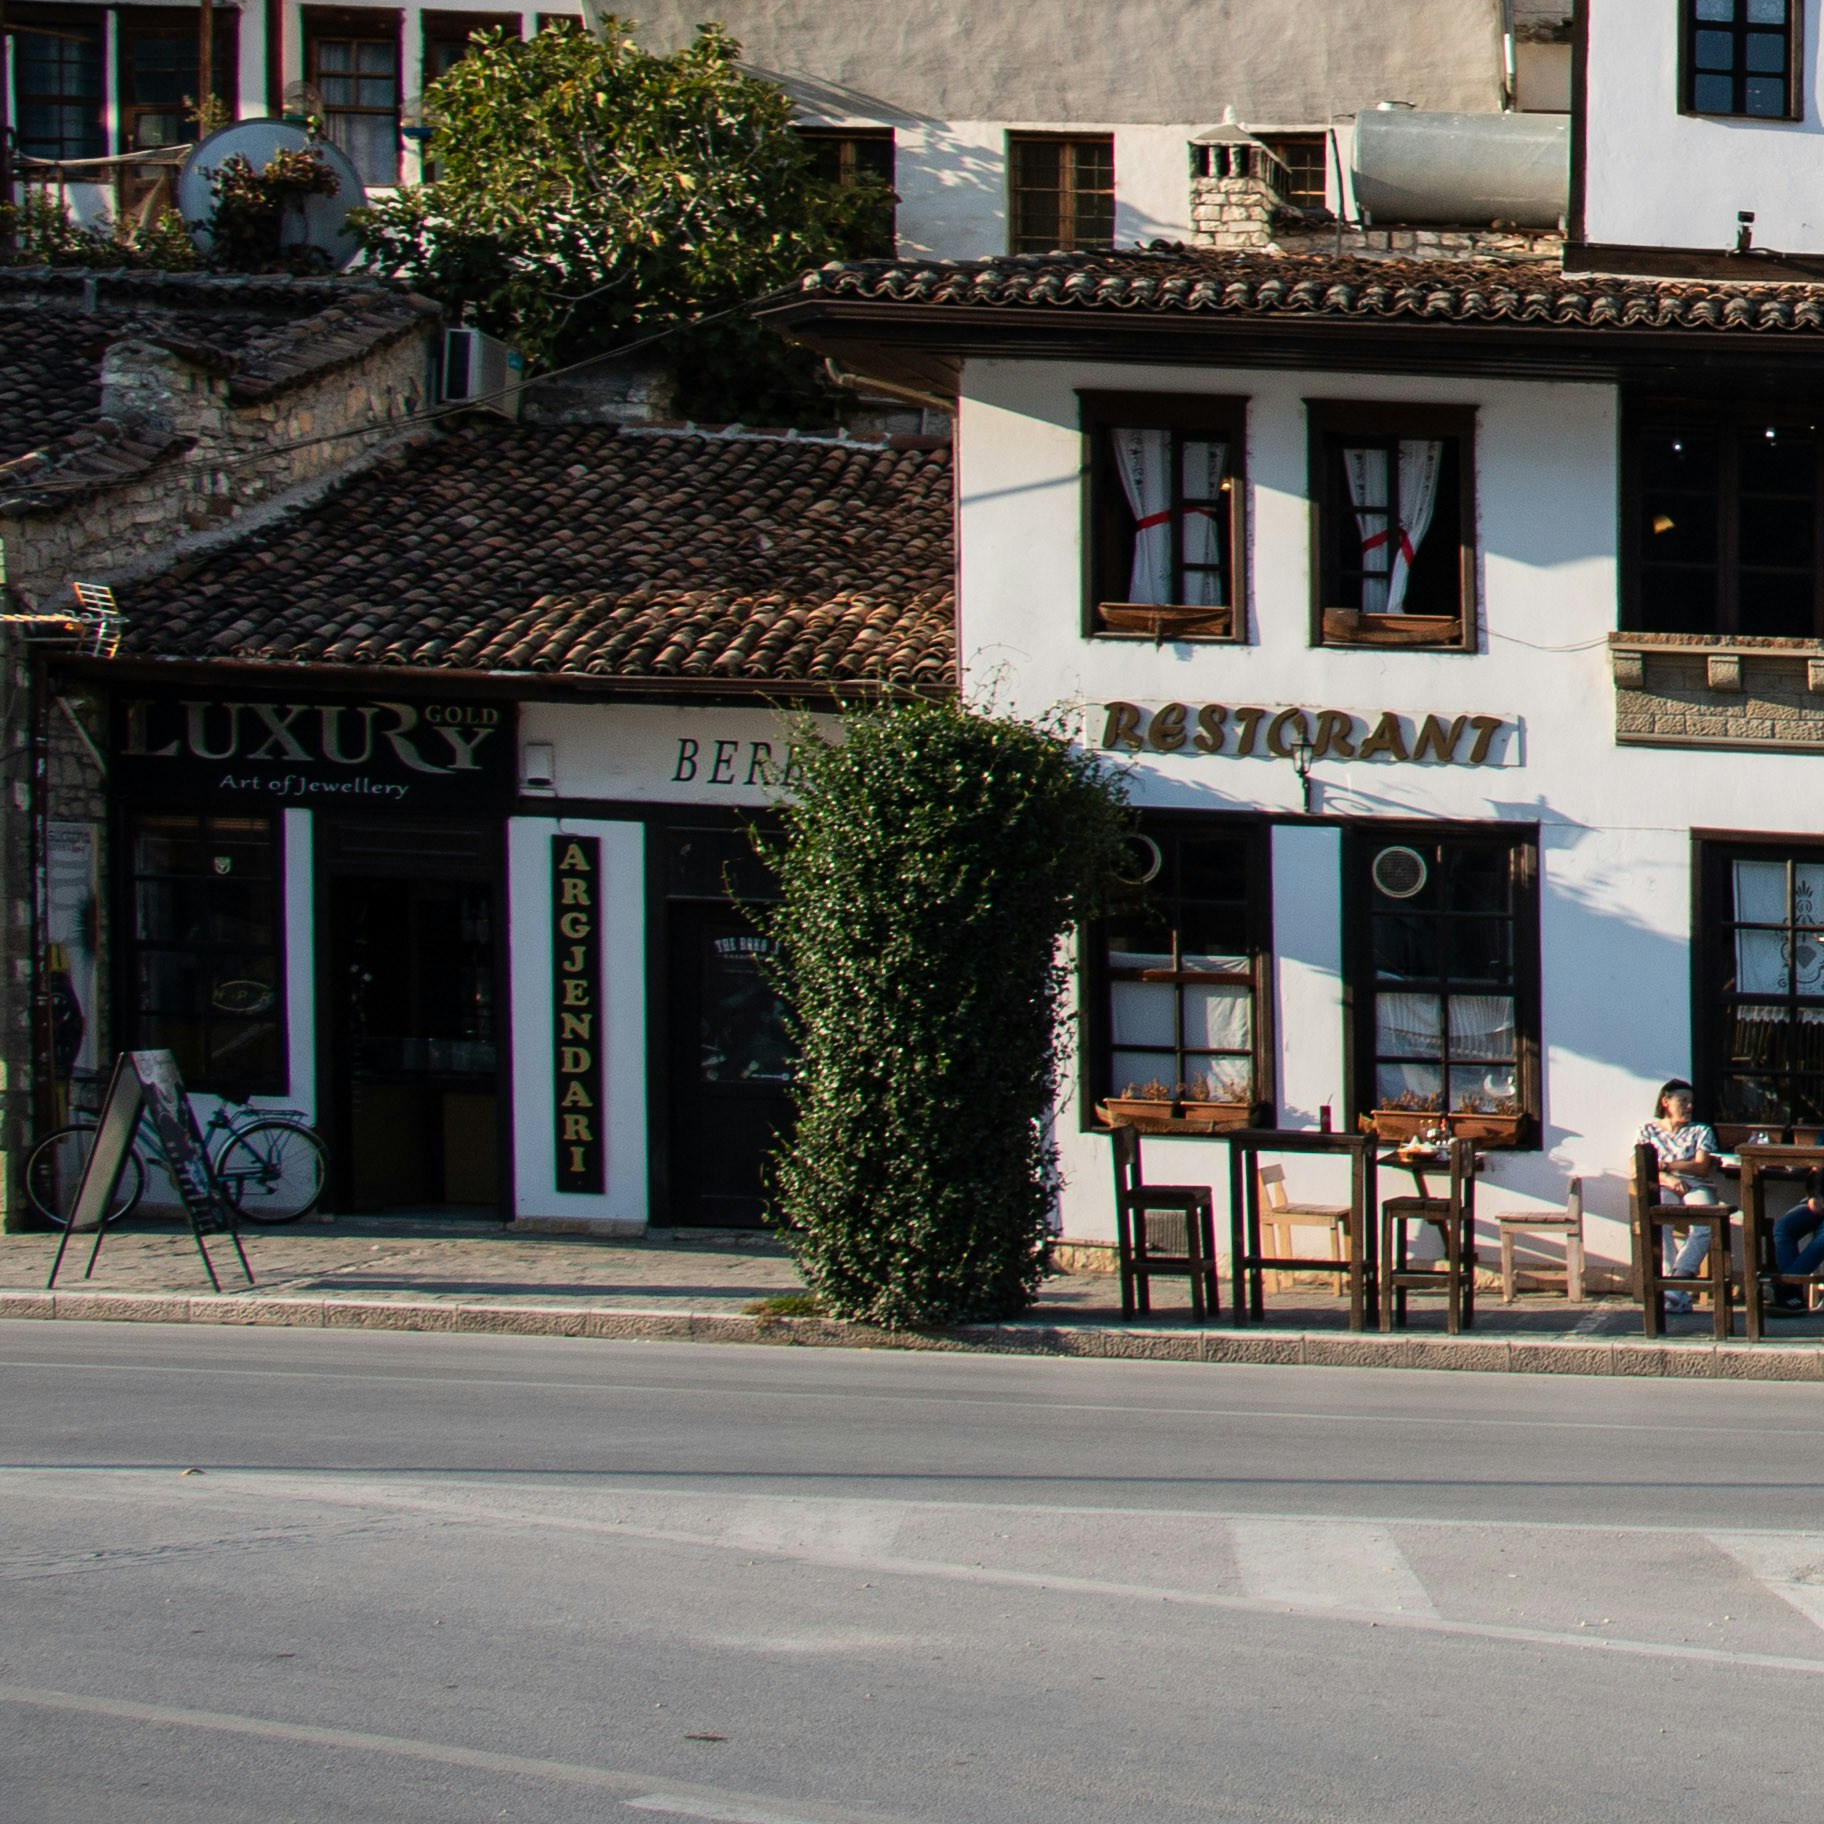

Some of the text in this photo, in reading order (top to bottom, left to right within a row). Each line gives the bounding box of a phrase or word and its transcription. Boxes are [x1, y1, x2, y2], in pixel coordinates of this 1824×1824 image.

[119, 698, 495, 774] LUXURY
[424, 704, 499, 725] GOLD
[1102, 701, 1502, 763] RESTORANT
[218, 773, 410, 800] Art of Jewellery
[559, 842, 594, 1173] ARGJENDARI
